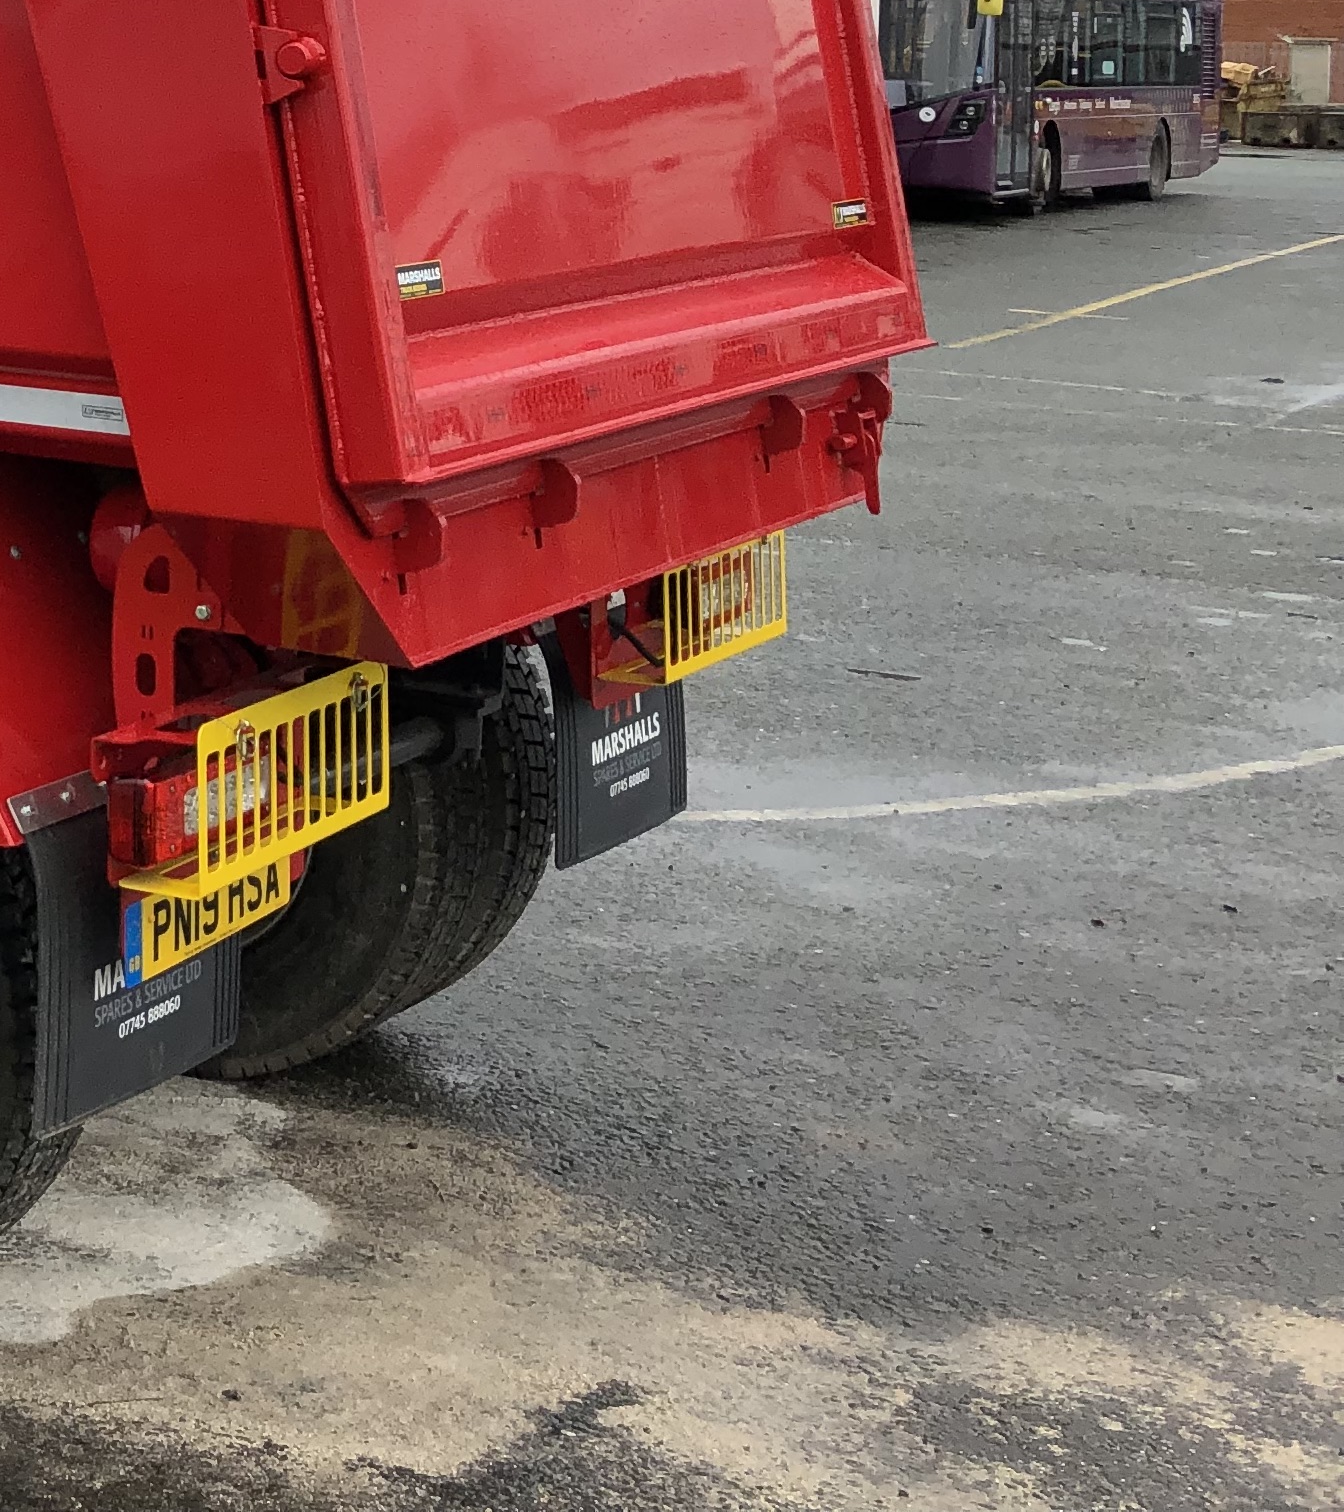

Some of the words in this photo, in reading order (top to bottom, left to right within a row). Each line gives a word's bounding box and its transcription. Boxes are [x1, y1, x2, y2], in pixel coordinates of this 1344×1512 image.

[397, 266, 441, 285] MARSHALLS
[591, 711, 661, 767] MARSHALLS
[609, 777, 628, 798] 07745
[153, 890, 220, 963] PN19
[228, 862, 280, 925] HSA
[94, 990, 134, 1028] SPARES
[135, 988, 143, 1009] &
[144, 966, 184, 1004] SERVICE
[185, 959, 202, 984] LTD
[118, 1011, 146, 1039] 07745
[147, 994, 181, 1024] 888060
